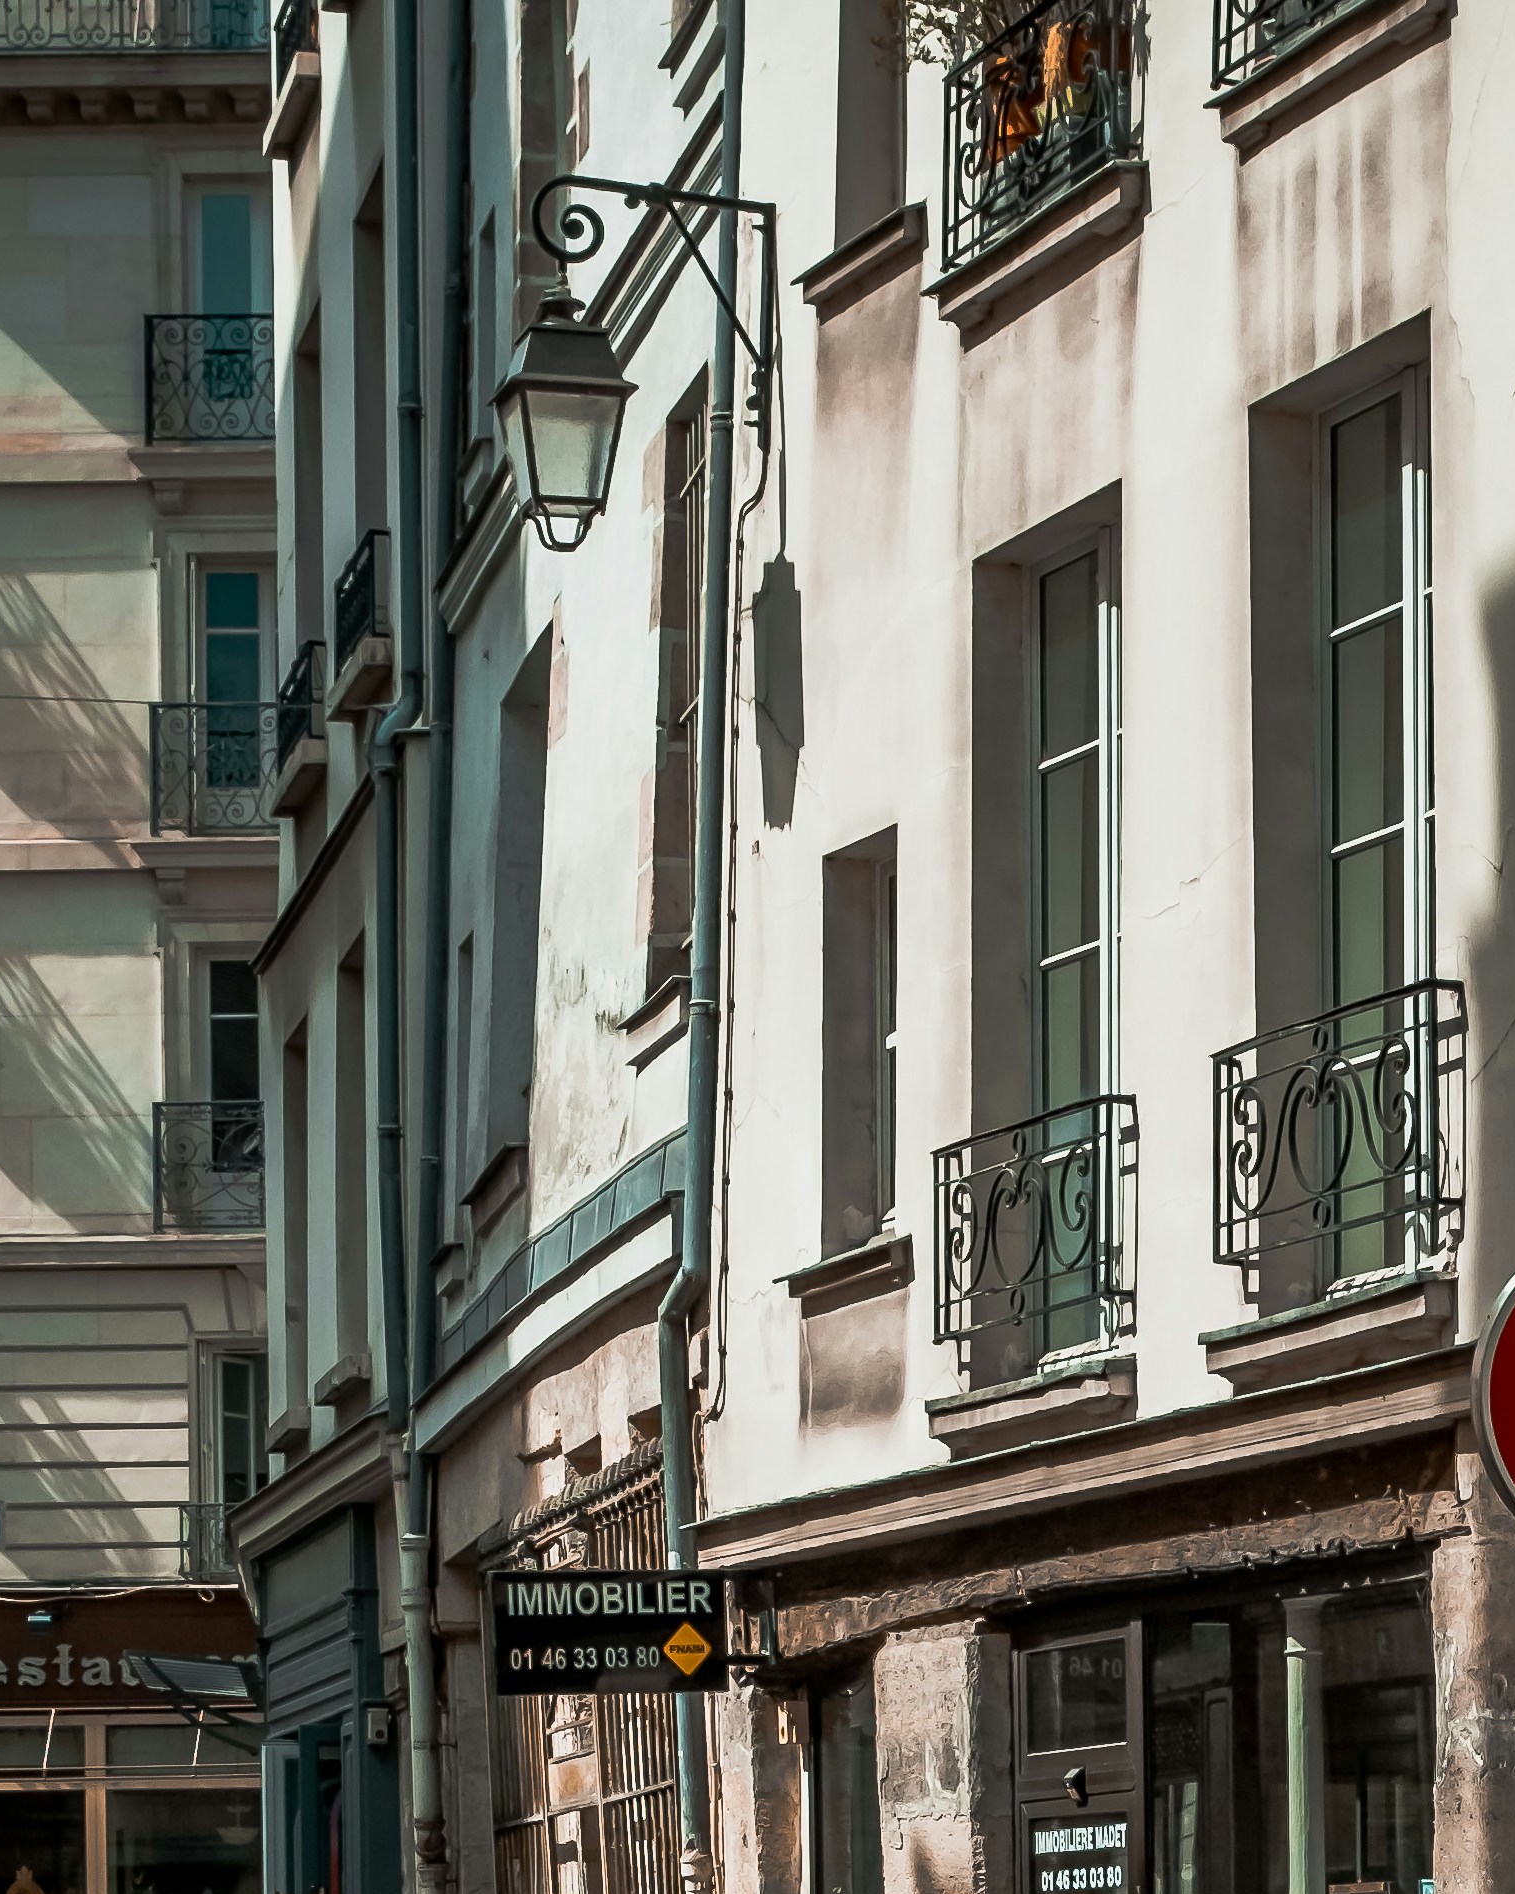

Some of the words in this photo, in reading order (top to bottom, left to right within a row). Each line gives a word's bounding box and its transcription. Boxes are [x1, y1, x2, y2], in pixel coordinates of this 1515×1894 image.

[506, 1580, 713, 1616] IMMOBILIER
[511, 1648, 533, 1671] 01
[541, 1648, 567, 1670] 46
[573, 1647, 598, 1669] 33
[605, 1646, 629, 1668] 03
[637, 1646, 660, 1668] 80
[1041, 1870, 1054, 1892] 01
[1056, 1869, 1070, 1890] 46
[1072, 1867, 1087, 1890] 33
[1089, 1866, 1105, 1889] 03
[1107, 1865, 1122, 1888] 80
